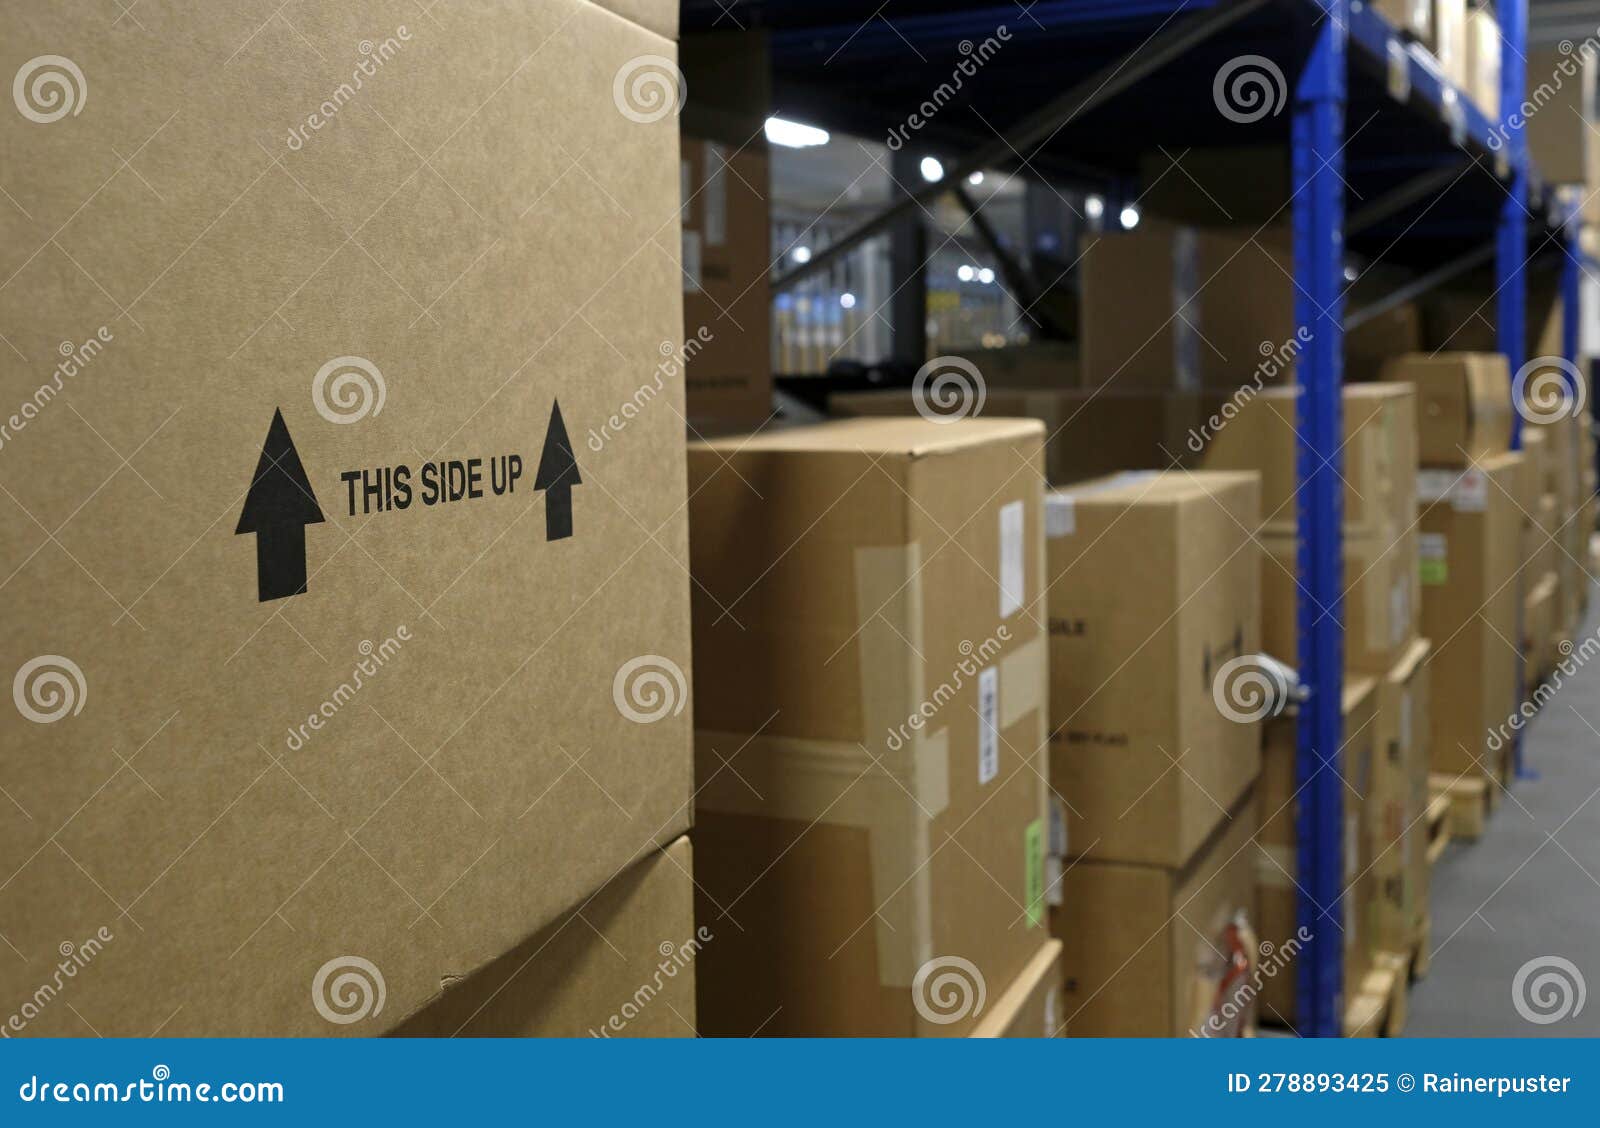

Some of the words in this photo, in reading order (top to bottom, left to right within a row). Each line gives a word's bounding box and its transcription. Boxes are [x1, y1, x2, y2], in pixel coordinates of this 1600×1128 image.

[341, 465, 412, 516] THIS
[421, 458, 483, 505] SIDE
[491, 454, 522, 496] UP
